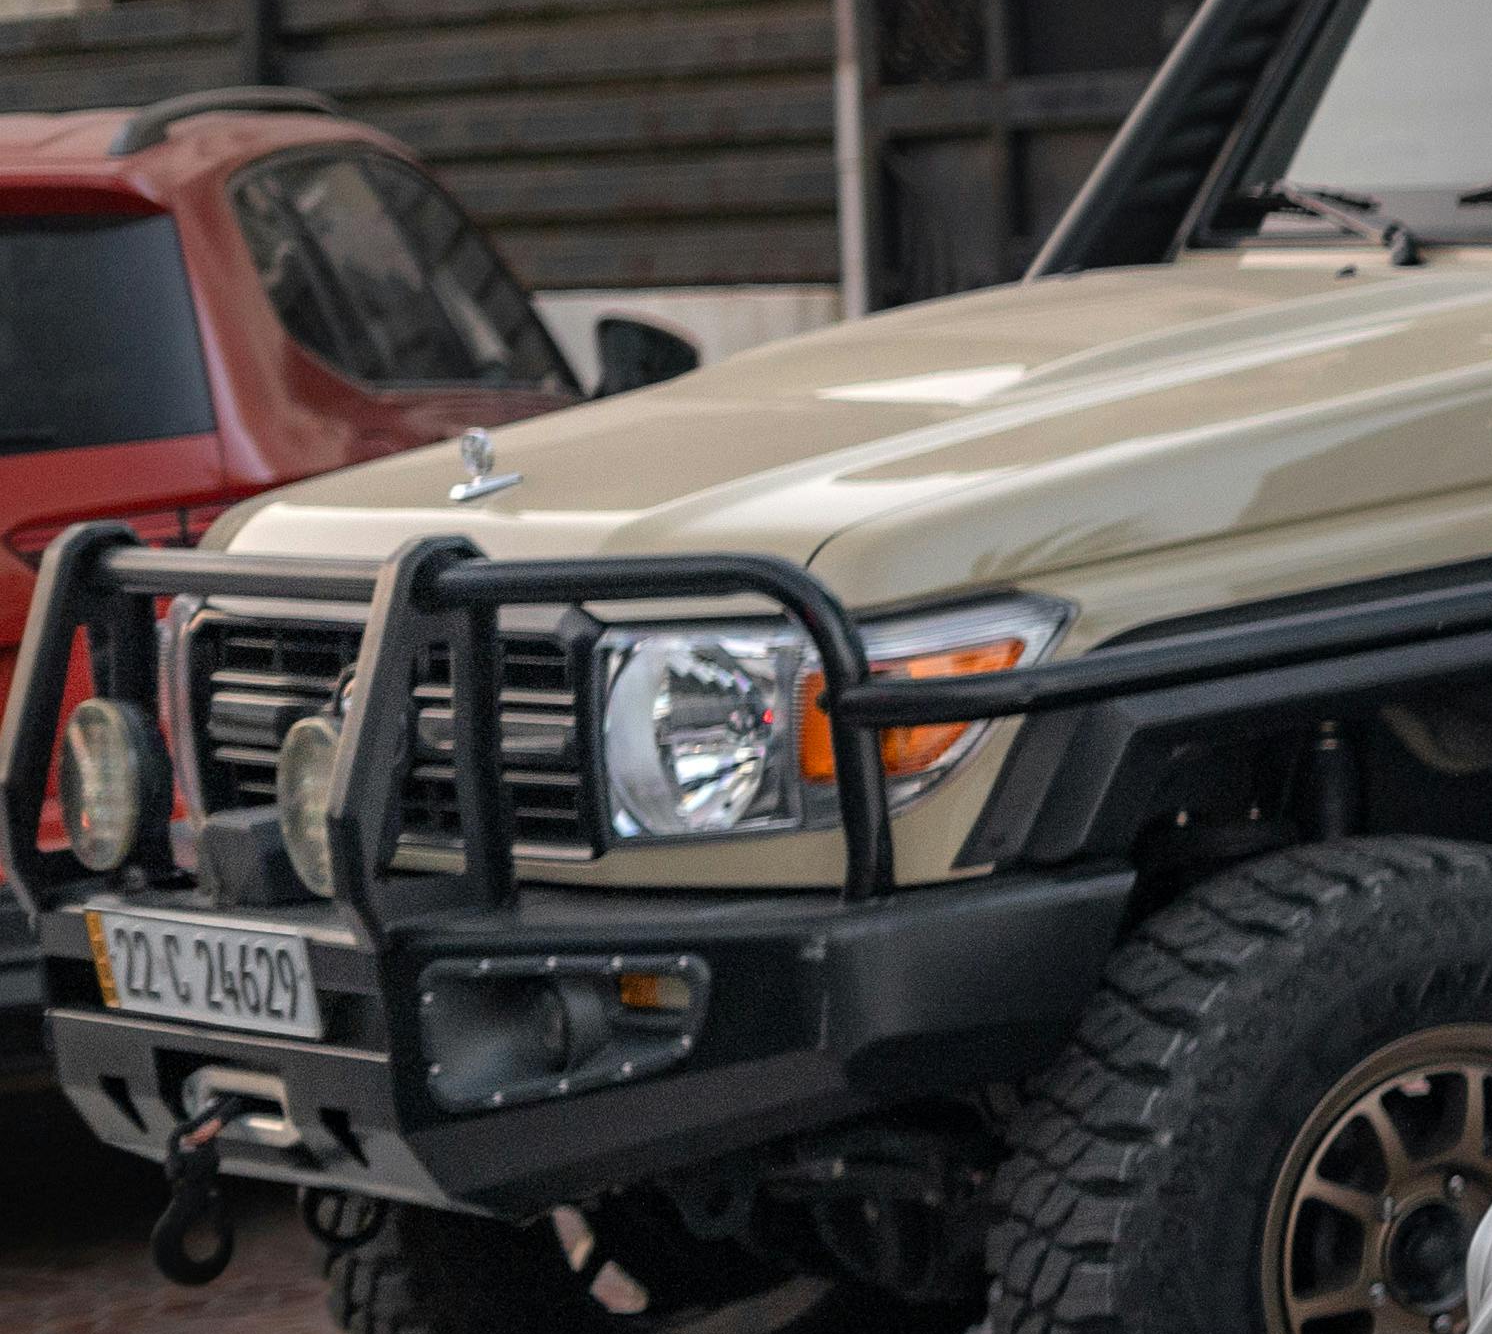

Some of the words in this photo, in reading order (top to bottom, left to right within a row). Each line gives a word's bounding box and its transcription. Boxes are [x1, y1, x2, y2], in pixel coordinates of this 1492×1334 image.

[113, 927, 161, 1000] 22
[163, 933, 192, 1006] C
[194, 938, 299, 1021] 24629
